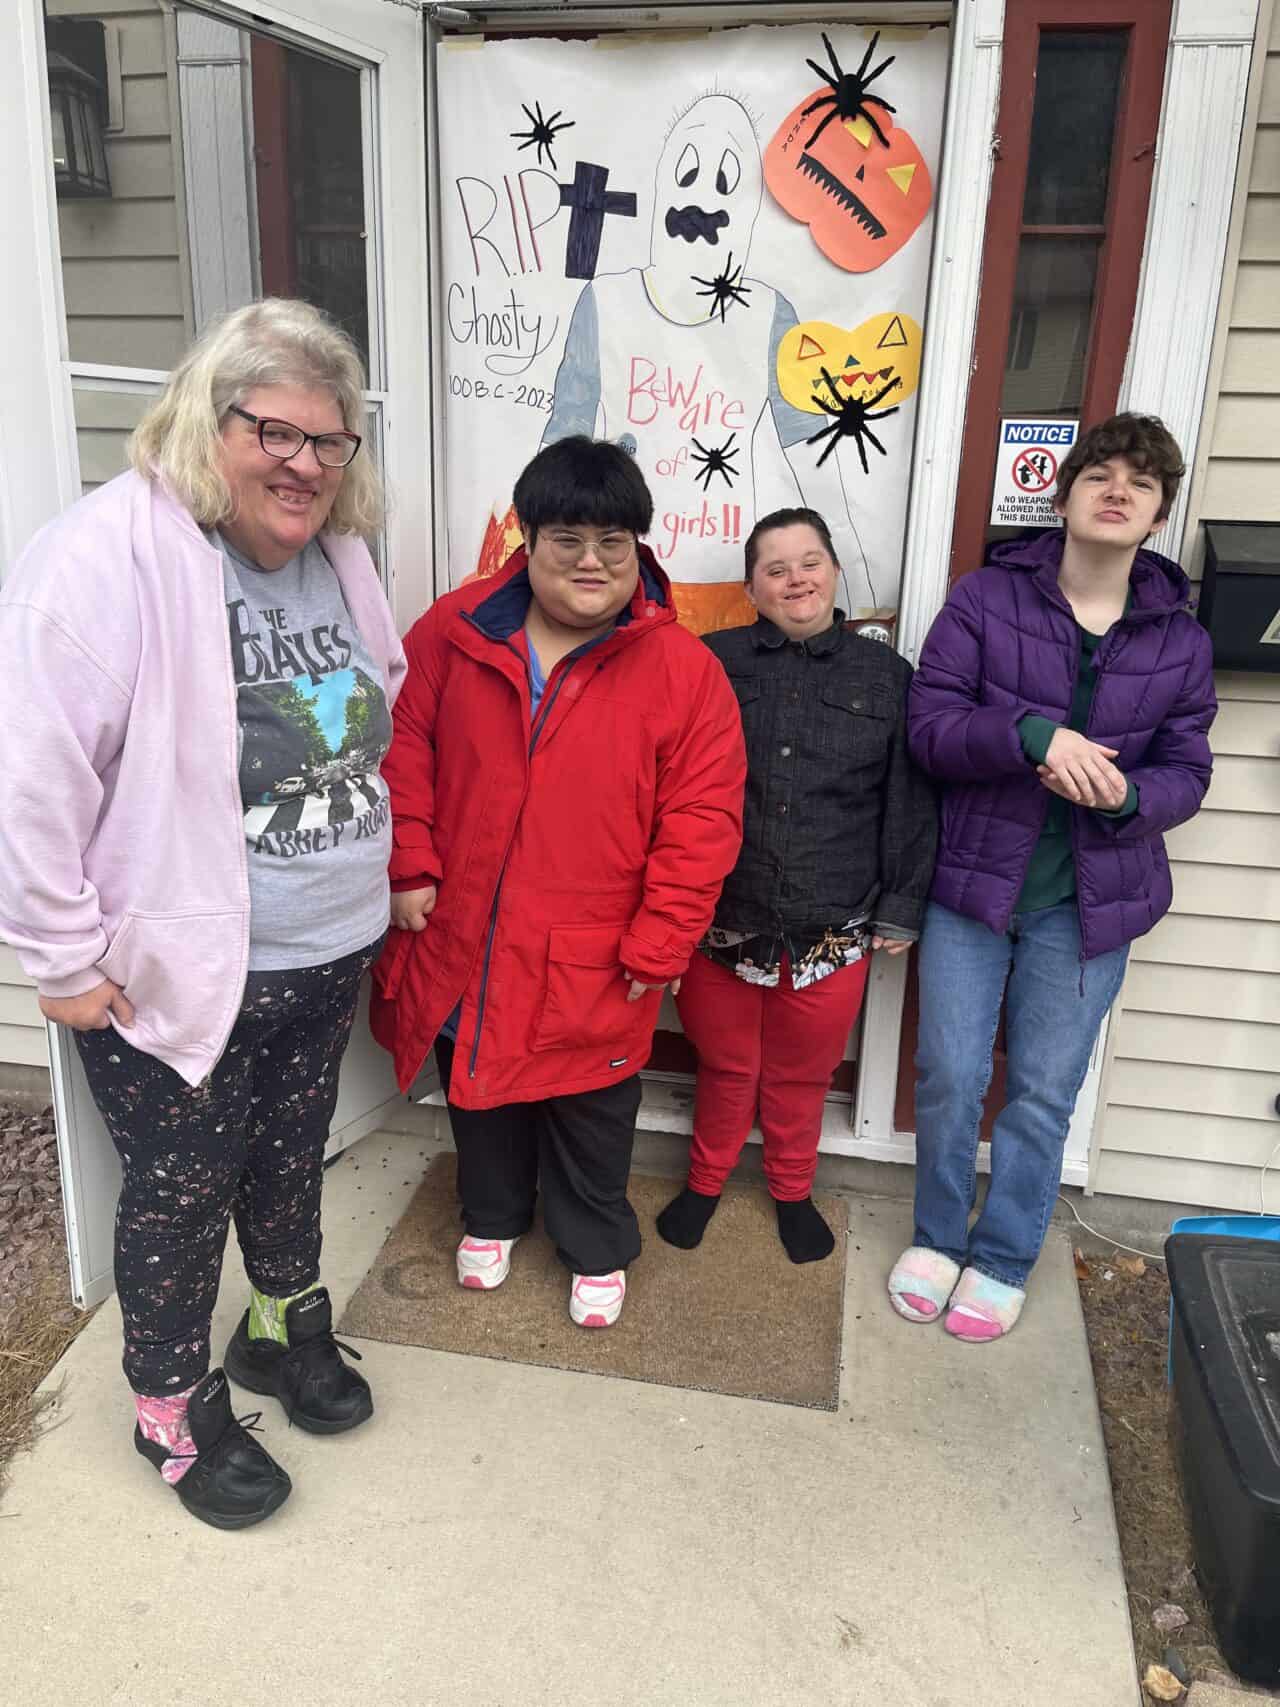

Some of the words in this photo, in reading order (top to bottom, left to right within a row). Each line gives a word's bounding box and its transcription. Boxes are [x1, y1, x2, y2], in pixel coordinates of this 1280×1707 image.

[447, 282, 559, 375] Ghosty
[1007, 426, 1072, 442] NOTICE
[655, 447, 688, 477] of
[1004, 495, 1016, 503] NO
[1018, 496, 1052, 504] WEAPON
[997, 504, 1034, 513] ALLOWED
[1036, 505, 1055, 514] INS
[1000, 513, 1018, 522] THIS
[1019, 514, 1059, 523] BUILDING
[254, 822, 345, 857] ABBEY
